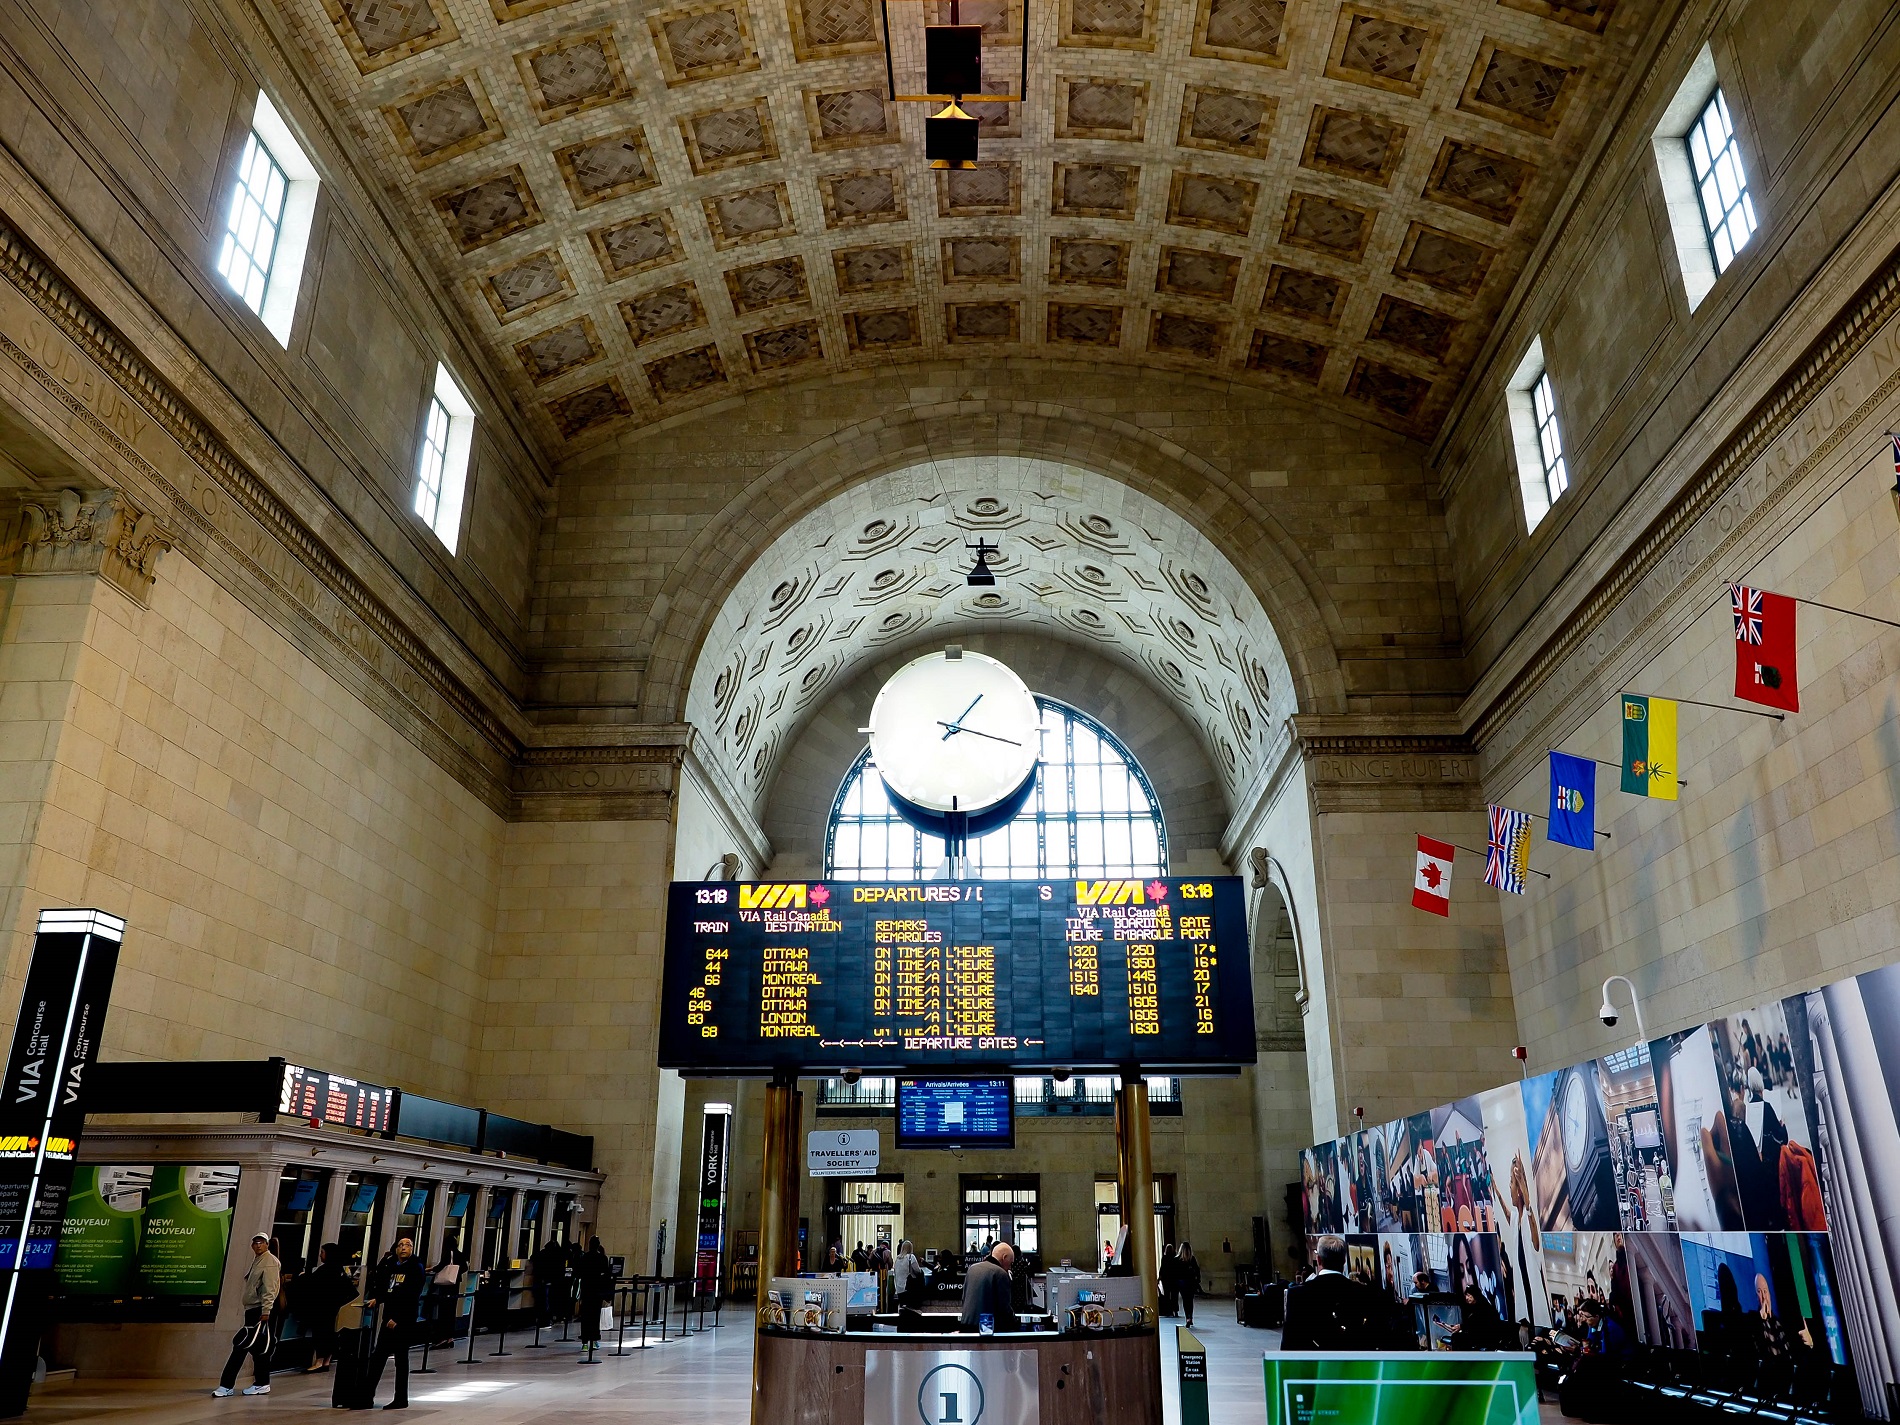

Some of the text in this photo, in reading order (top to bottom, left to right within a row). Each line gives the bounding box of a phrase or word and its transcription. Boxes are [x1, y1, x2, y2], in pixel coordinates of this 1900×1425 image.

[24, 320, 147, 444] SUDBURY
[518, 769, 665, 788] VANCOUVER
[1180, 884, 1213, 898] 13:18
[739, 906, 1170, 922] VIA Rail Canada VIA Rail Canada
[694, 917, 1210, 932] TRAIN DESTINATION REMARKS TIME BOARDING GATE
[875, 928, 1211, 943] REMARQUES HEURE EMBARQUE PORT
[706, 949, 728, 960] 644
[764, 948, 808, 959] OTTAWA
[875, 947, 890, 958] ON
[897, 946, 940, 958] TIME/A
[946, 946, 994, 958] L'HEURE
[1069, 945, 1097, 956] 1320
[1127, 945, 1154, 956] 1250
[706, 962, 721, 972] 44
[763, 961, 807, 972] OTTAWA
[875, 960, 890, 971] ON
[897, 960, 940, 971] TIME/A
[946, 958, 994, 971] L'HEURE
[1070, 958, 1097, 969] 1420
[1127, 957, 1155, 969] 1350
[705, 970, 1210, 985] 66 MONTREAL ON TIME/A L'HEURE 1515 1445 20
[690, 983, 1210, 998] 46 OTTAWA ON TIME/A L'HEURE 1540 1510 17
[689, 996, 1209, 1011] 646 OTTAWA ON TIME/A L'HEURE 1605 21
[688, 1013, 703, 1024] 83
[761, 1012, 806, 1024] LONDON
[946, 1011, 995, 1022] L'HEURE
[1130, 1010, 1158, 1023] 1605
[1199, 1010, 1212, 1020] 16
[26, 1001, 46, 1056] Concourse
[73, 1003, 90, 1058] Concourse
[702, 1026, 717, 1037] 68
[761, 1025, 820, 1037] MONTREAL
[946, 1023, 995, 1036] L'HEURE
[1131, 1023, 1159, 1034] 1630
[1197, 1023, 1213, 1033] 20
[37, 1035, 50, 1056] Hall
[81, 1039, 90, 1060] Hall
[905, 1037, 1017, 1049] DEPARTURE GATES
[15, 1059, 44, 1104] VIA
[64, 1063, 85, 1105] VIA
[46, 1137, 69, 1152] VIA
[707, 1155, 718, 1185] YORK
[703, 1199, 718, 1207] GO
[62, 1218, 110, 1226] NOUVEAU!
[149, 1219, 174, 1227] NEW!
[61, 1227, 85, 1235] NEW!
[147, 1227, 196, 1235] NOUVEAU!
[32, 1244, 52, 1253] 24-27
